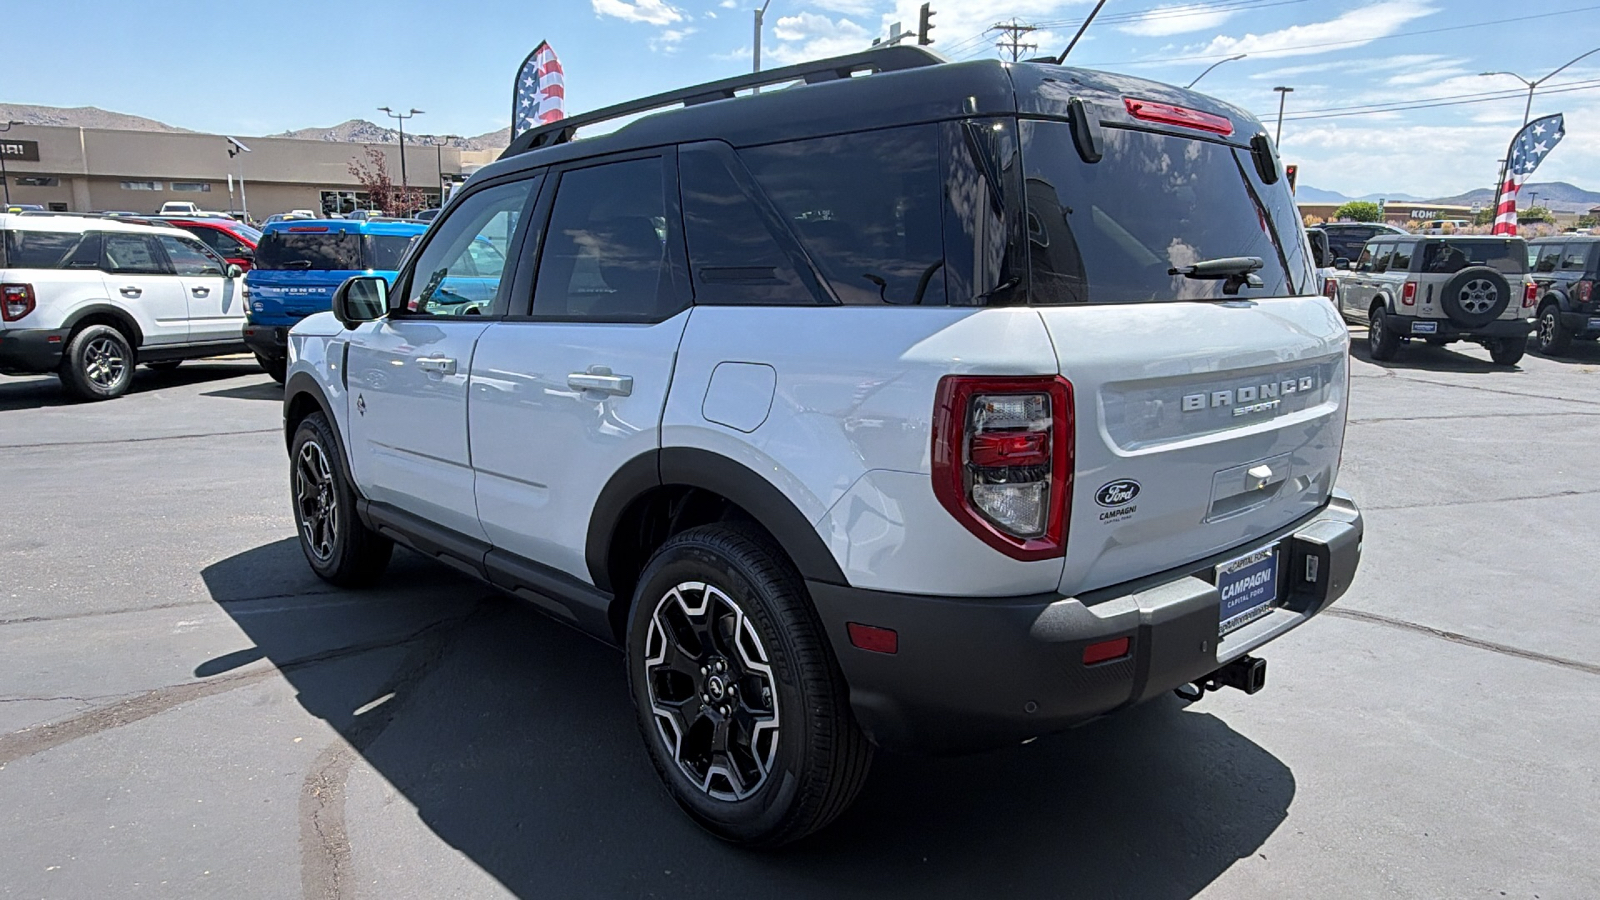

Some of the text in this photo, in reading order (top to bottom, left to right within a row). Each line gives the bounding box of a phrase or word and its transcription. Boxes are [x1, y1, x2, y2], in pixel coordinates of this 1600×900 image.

[1182, 376, 1312, 412] BRONCO
[1232, 399, 1281, 417] SPORT
[1105, 484, 1134, 503] Ford
[1099, 505, 1137, 521] CAMPAGNI
[1221, 567, 1271, 601] CAMPAGNI
[1227, 587, 1264, 609] CAPITAL FORD
